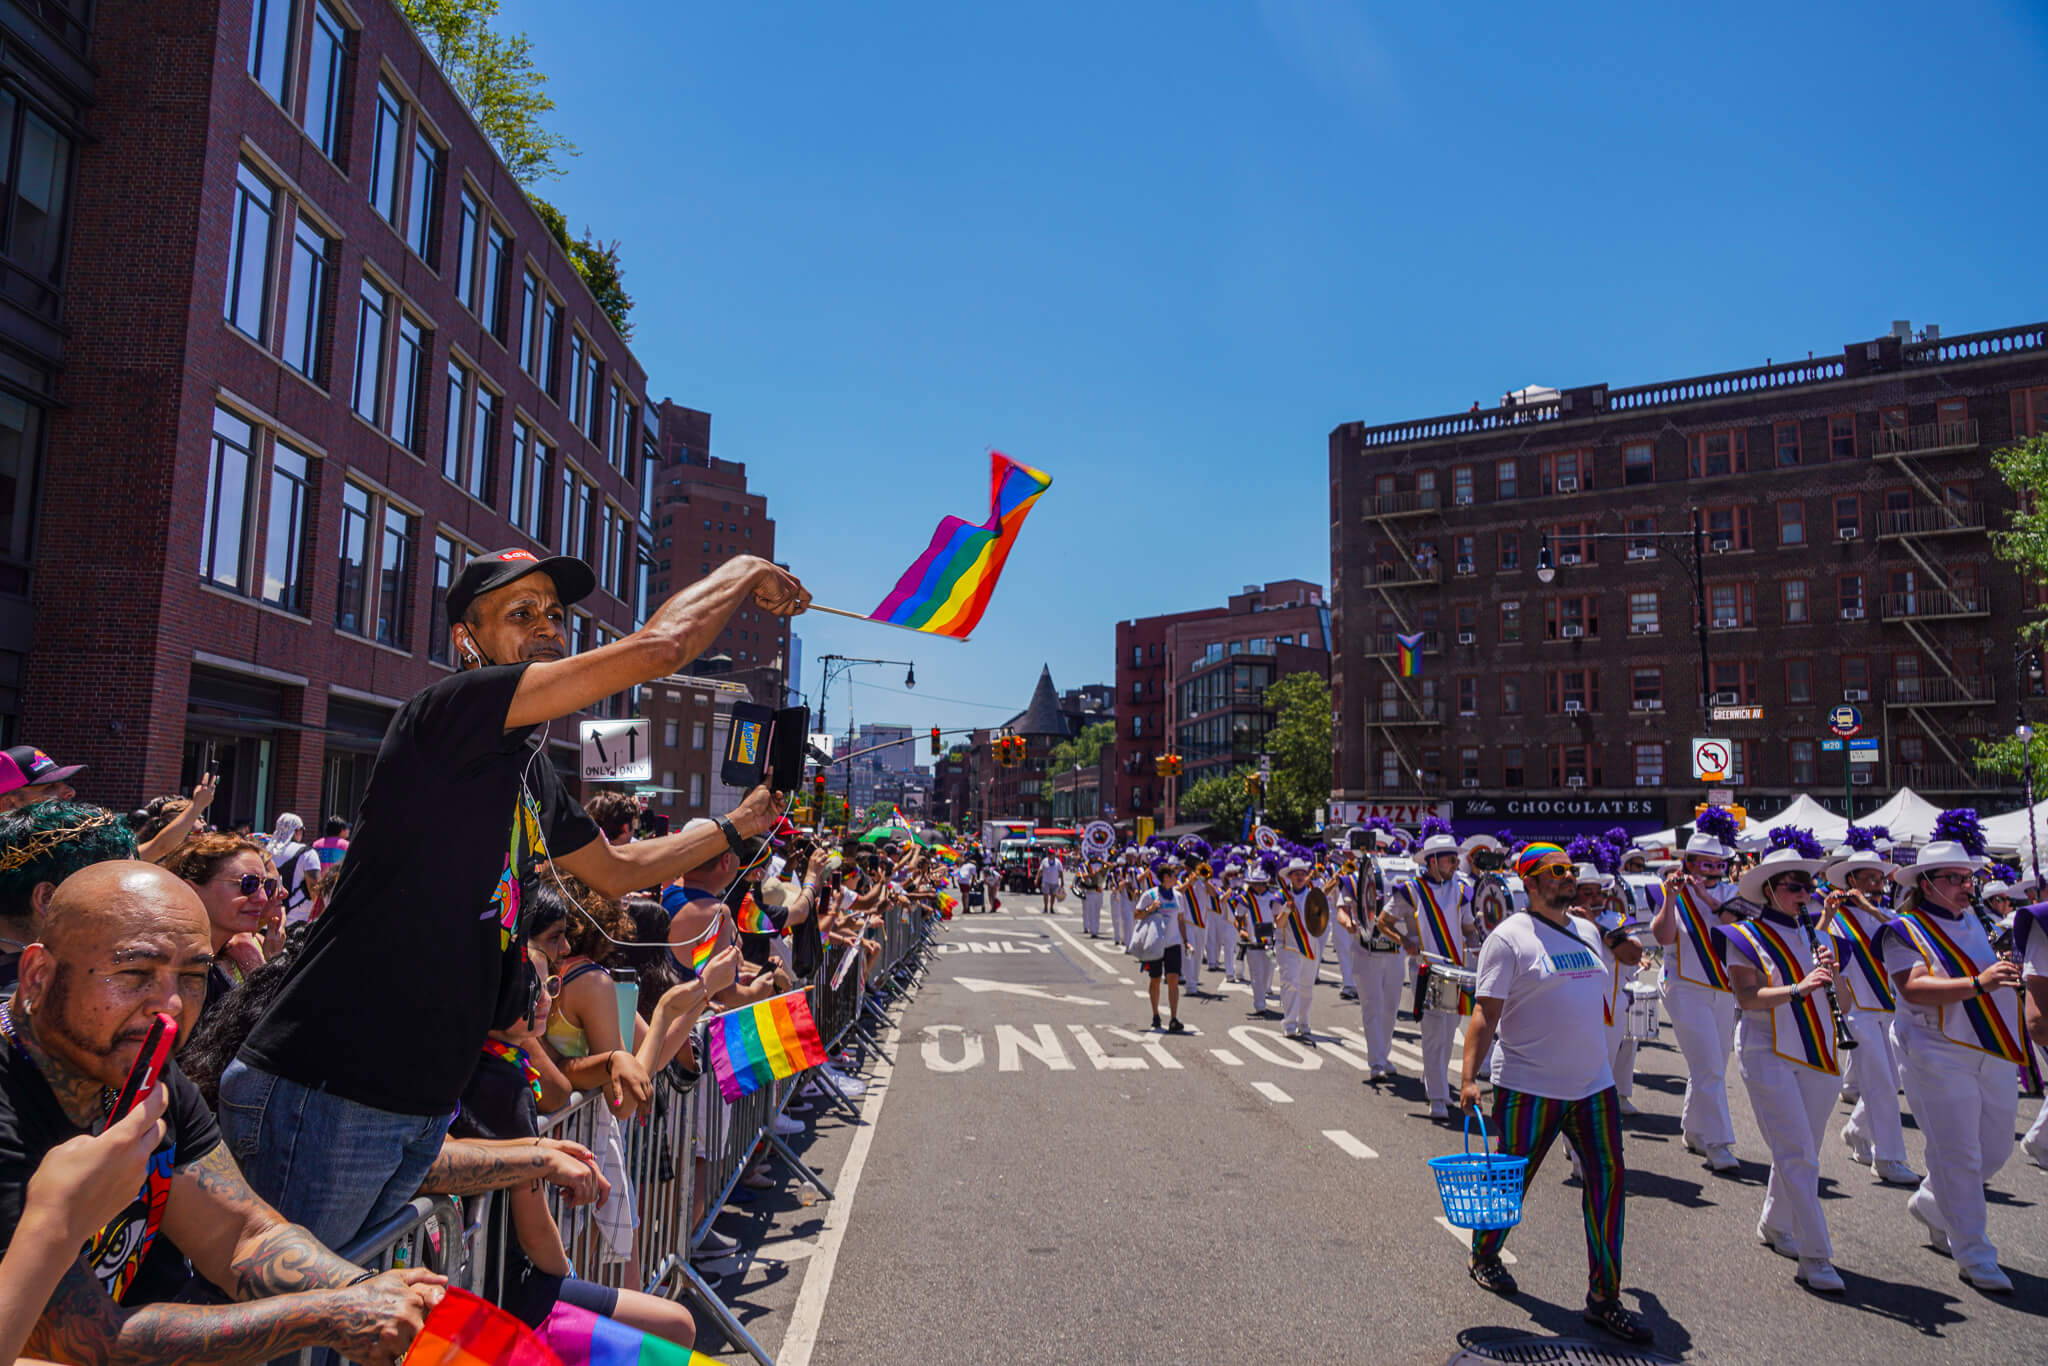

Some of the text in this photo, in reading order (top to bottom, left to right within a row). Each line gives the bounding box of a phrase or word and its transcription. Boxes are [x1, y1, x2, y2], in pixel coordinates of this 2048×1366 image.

[585, 765, 645, 776] ONLY ONLY
[1356, 805, 1439, 823] ZAZZY'S
[1507, 800, 1653, 814] CHOCOLATES
[937, 941, 1063, 954] ONLY
[921, 1023, 1185, 1072] ONLY
